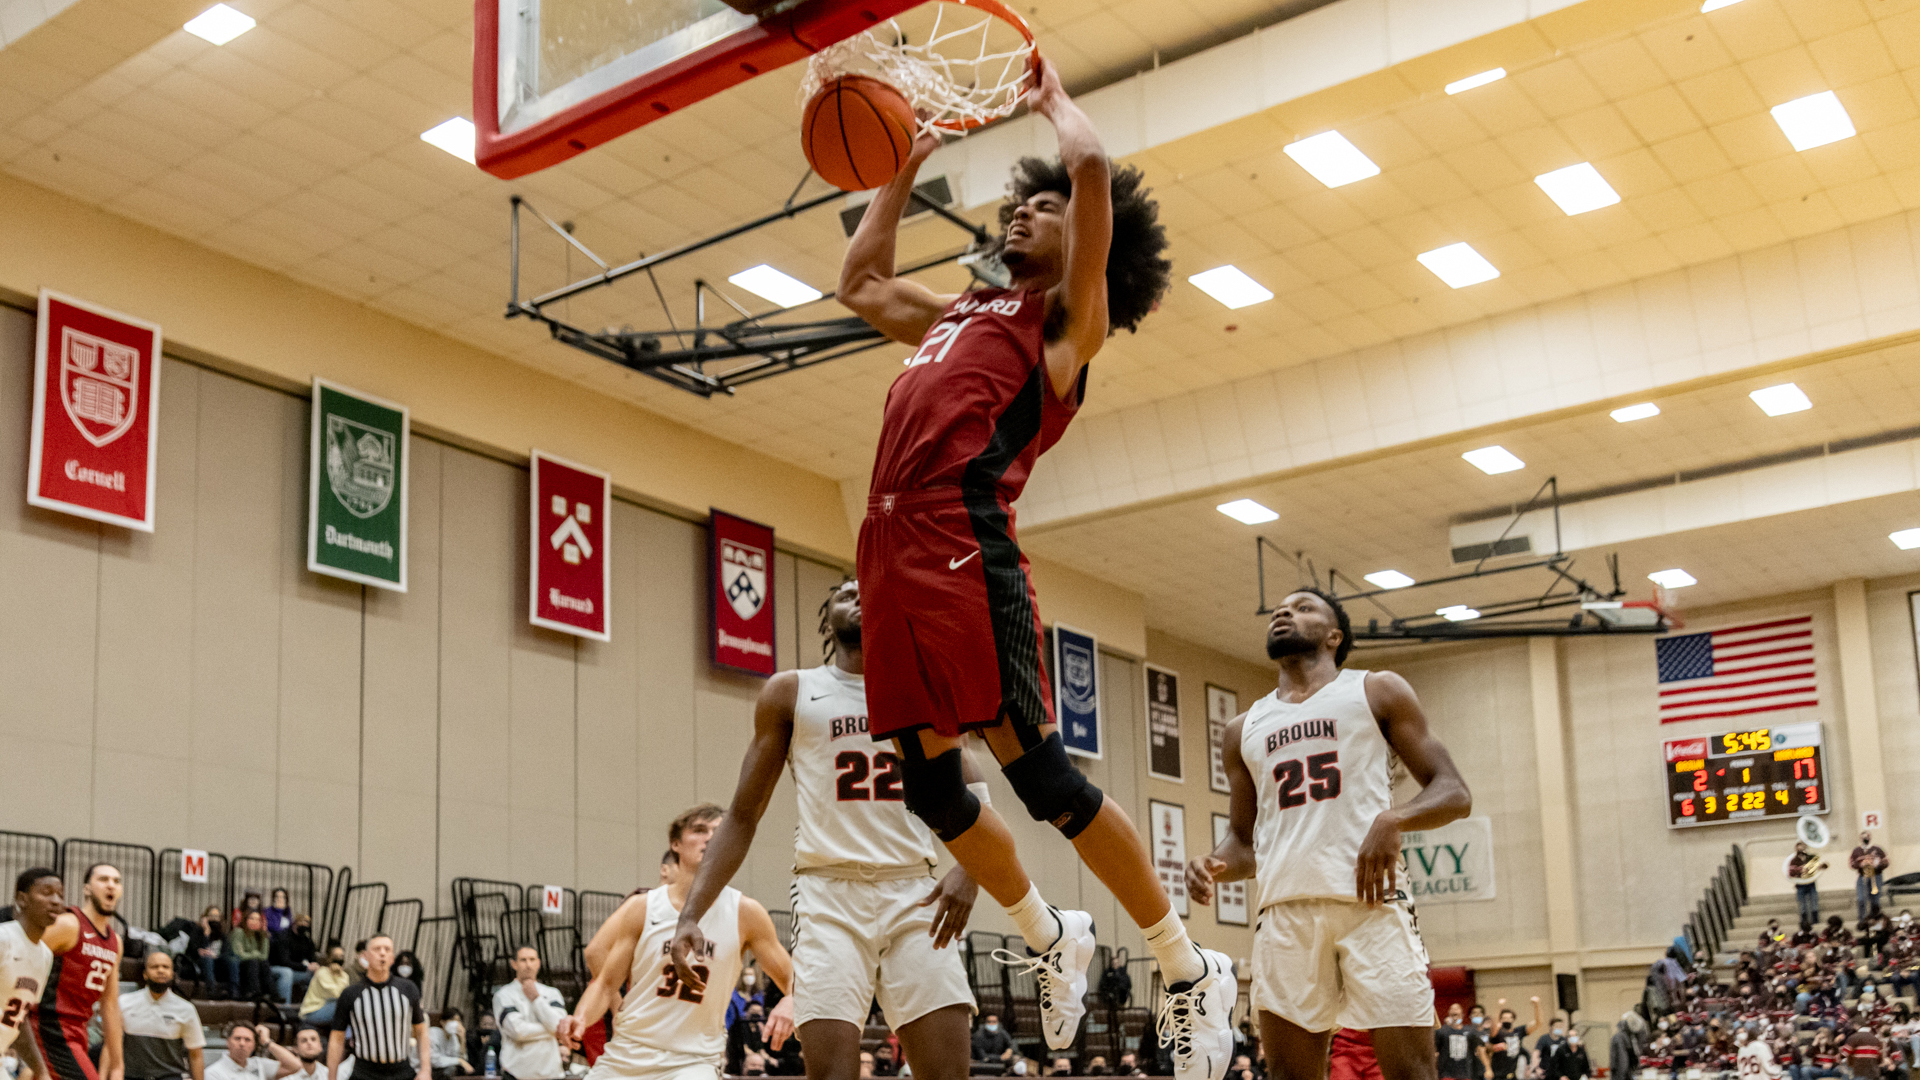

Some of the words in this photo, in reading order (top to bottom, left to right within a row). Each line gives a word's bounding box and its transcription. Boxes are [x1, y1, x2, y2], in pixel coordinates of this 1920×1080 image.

[908, 316, 973, 368] 21
[64, 459, 126, 492] Cornell
[830, 715, 869, 741] BRO
[1265, 718, 1338, 757] BROWN
[1723, 729, 1771, 754] 5:45
[835, 751, 904, 801] 22
[1793, 758, 1816, 779] 17
[1273, 751, 1342, 811] 25
[1693, 769, 1708, 791] 2
[1704, 796, 1717, 814] 3
[1775, 789, 1789, 805] 4
[1804, 786, 1818, 804] 3
[1681, 798, 1695, 816] 6
[1866, 815, 1879, 827] R
[185, 855, 204, 876] M
[1411, 877, 1474, 897] EAGUE
[547, 891, 559, 908] N
